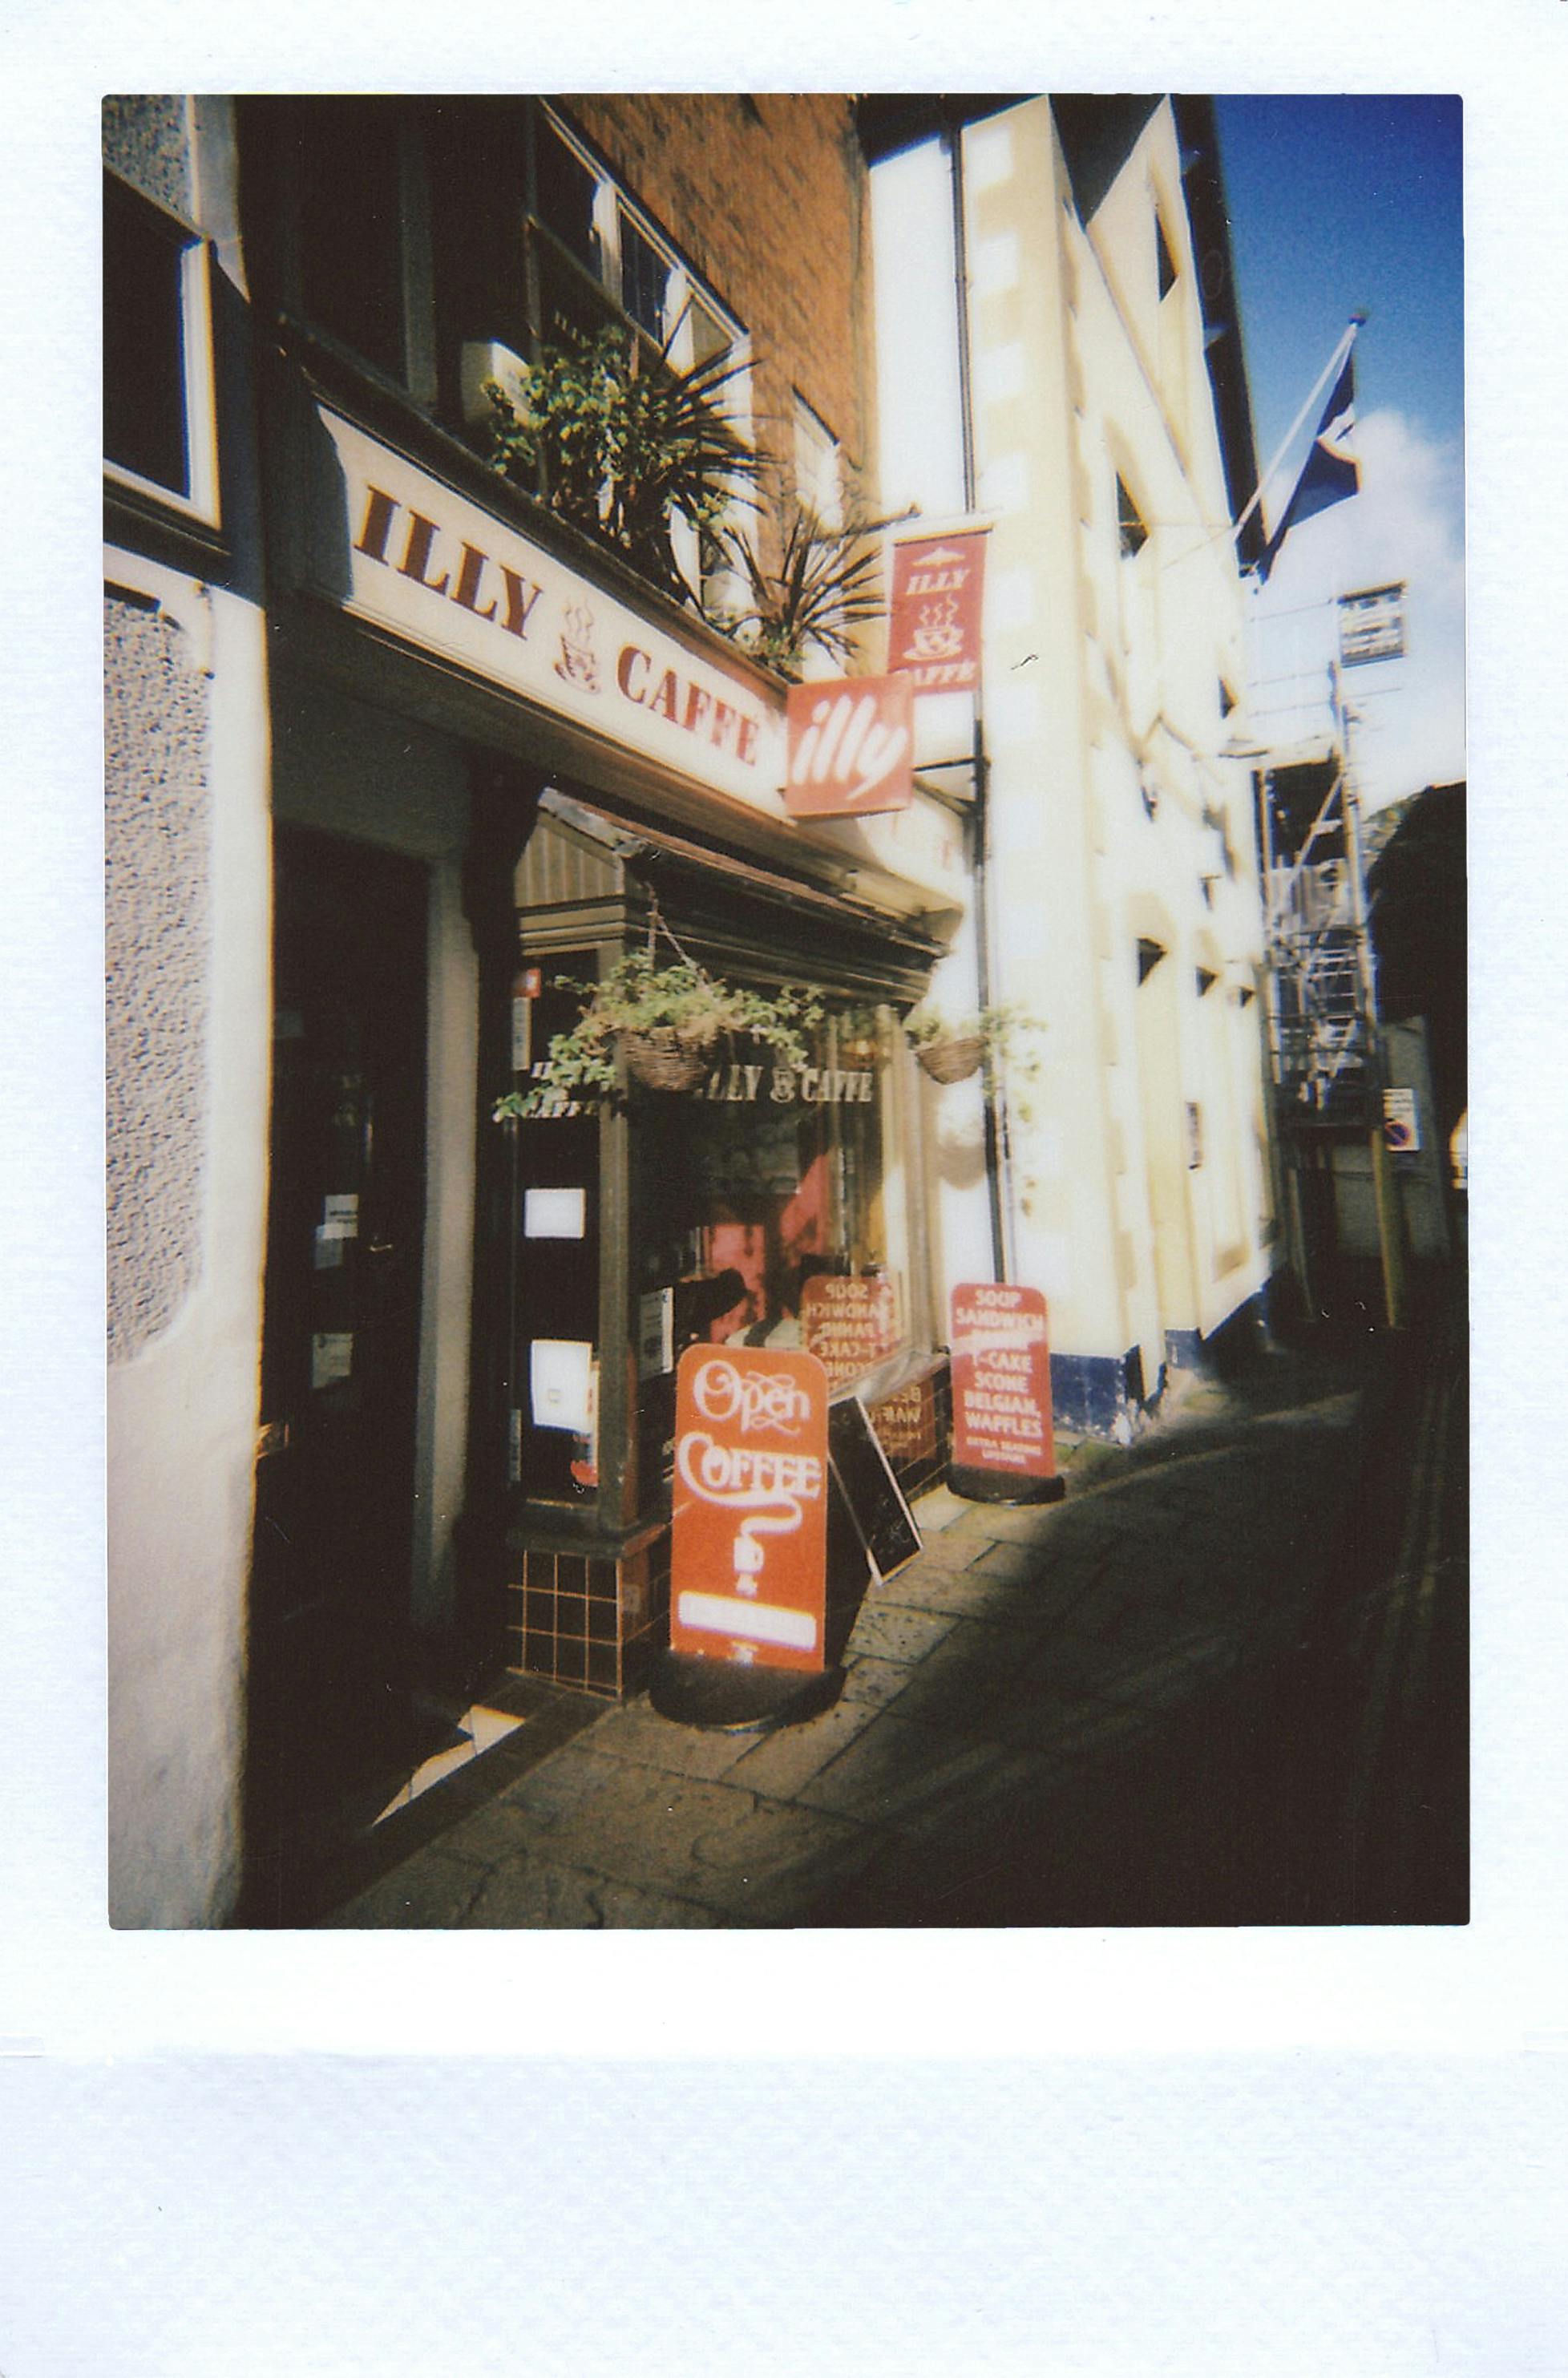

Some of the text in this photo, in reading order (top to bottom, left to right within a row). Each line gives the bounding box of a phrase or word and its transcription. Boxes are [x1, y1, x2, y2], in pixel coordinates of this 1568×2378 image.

[906, 568, 970, 596] ILLY
[354, 483, 759, 767] ILLY CAFFE
[791, 694, 908, 801] illy
[975, 1289, 1020, 1308] SOUP
[975, 1372, 1028, 1393] SCONE
[693, 1360, 810, 1436] Open
[965, 1412, 1043, 1438] WAFFLES
